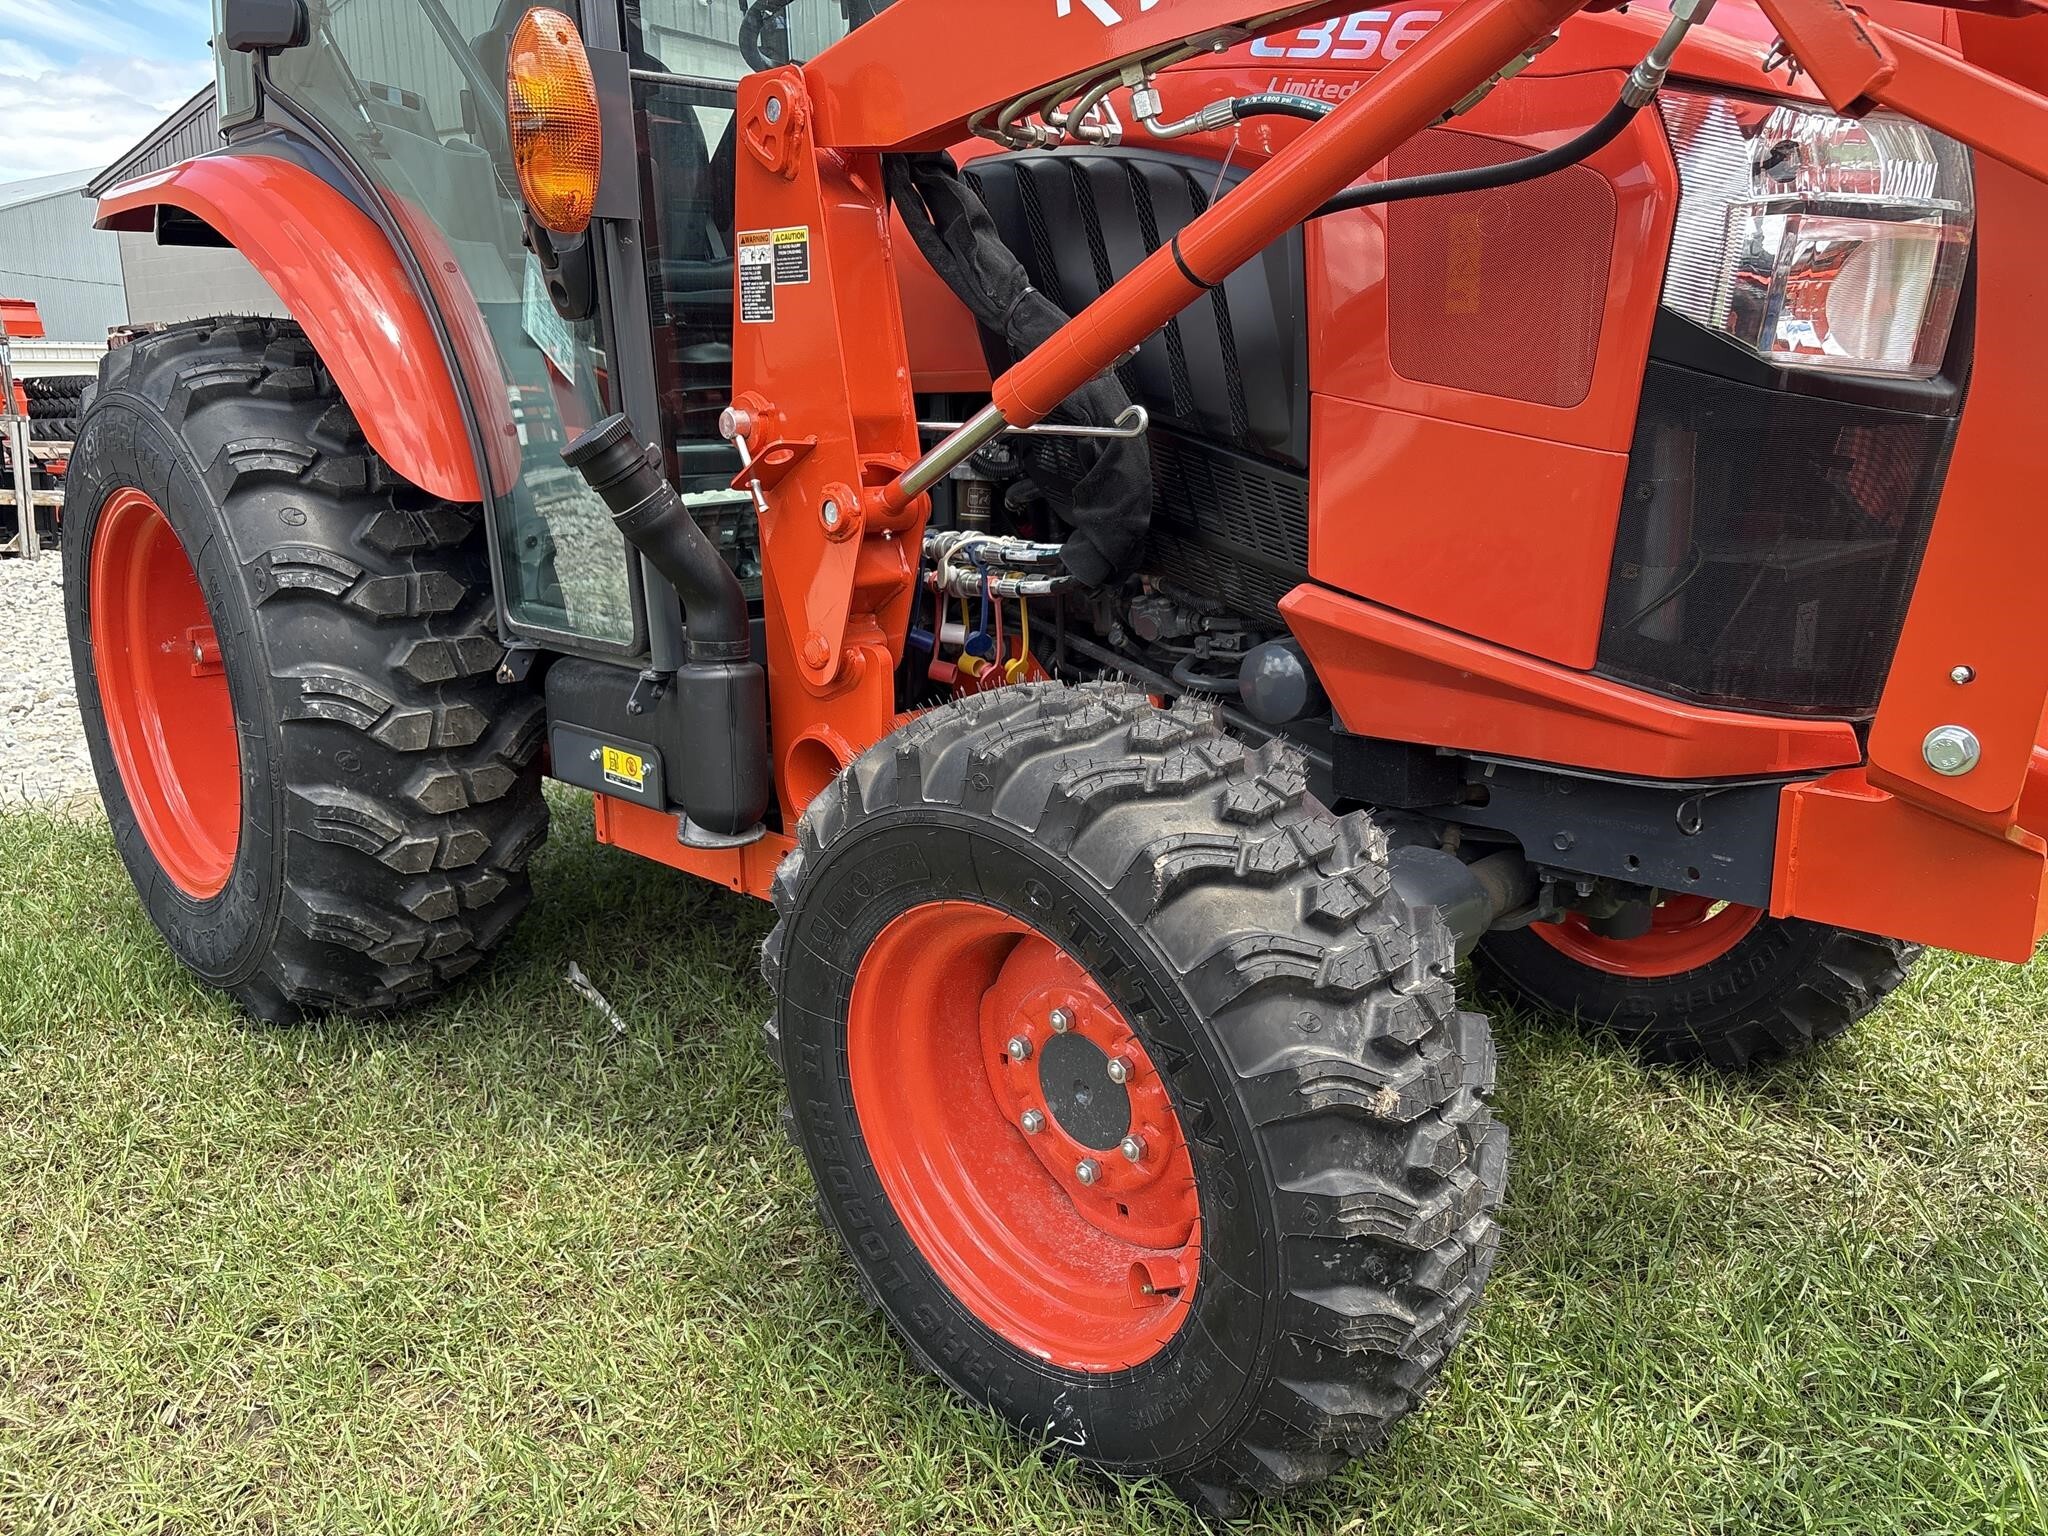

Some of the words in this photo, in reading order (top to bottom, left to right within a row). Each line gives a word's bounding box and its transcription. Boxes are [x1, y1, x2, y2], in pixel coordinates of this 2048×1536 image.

[1267, 76, 1360, 99] Limited
[745, 234, 769, 243] WARNING
[780, 231, 805, 242] CAUTION
[1066, 904, 1226, 1153] TITAN
[803, 1098, 919, 1297] LOADER
